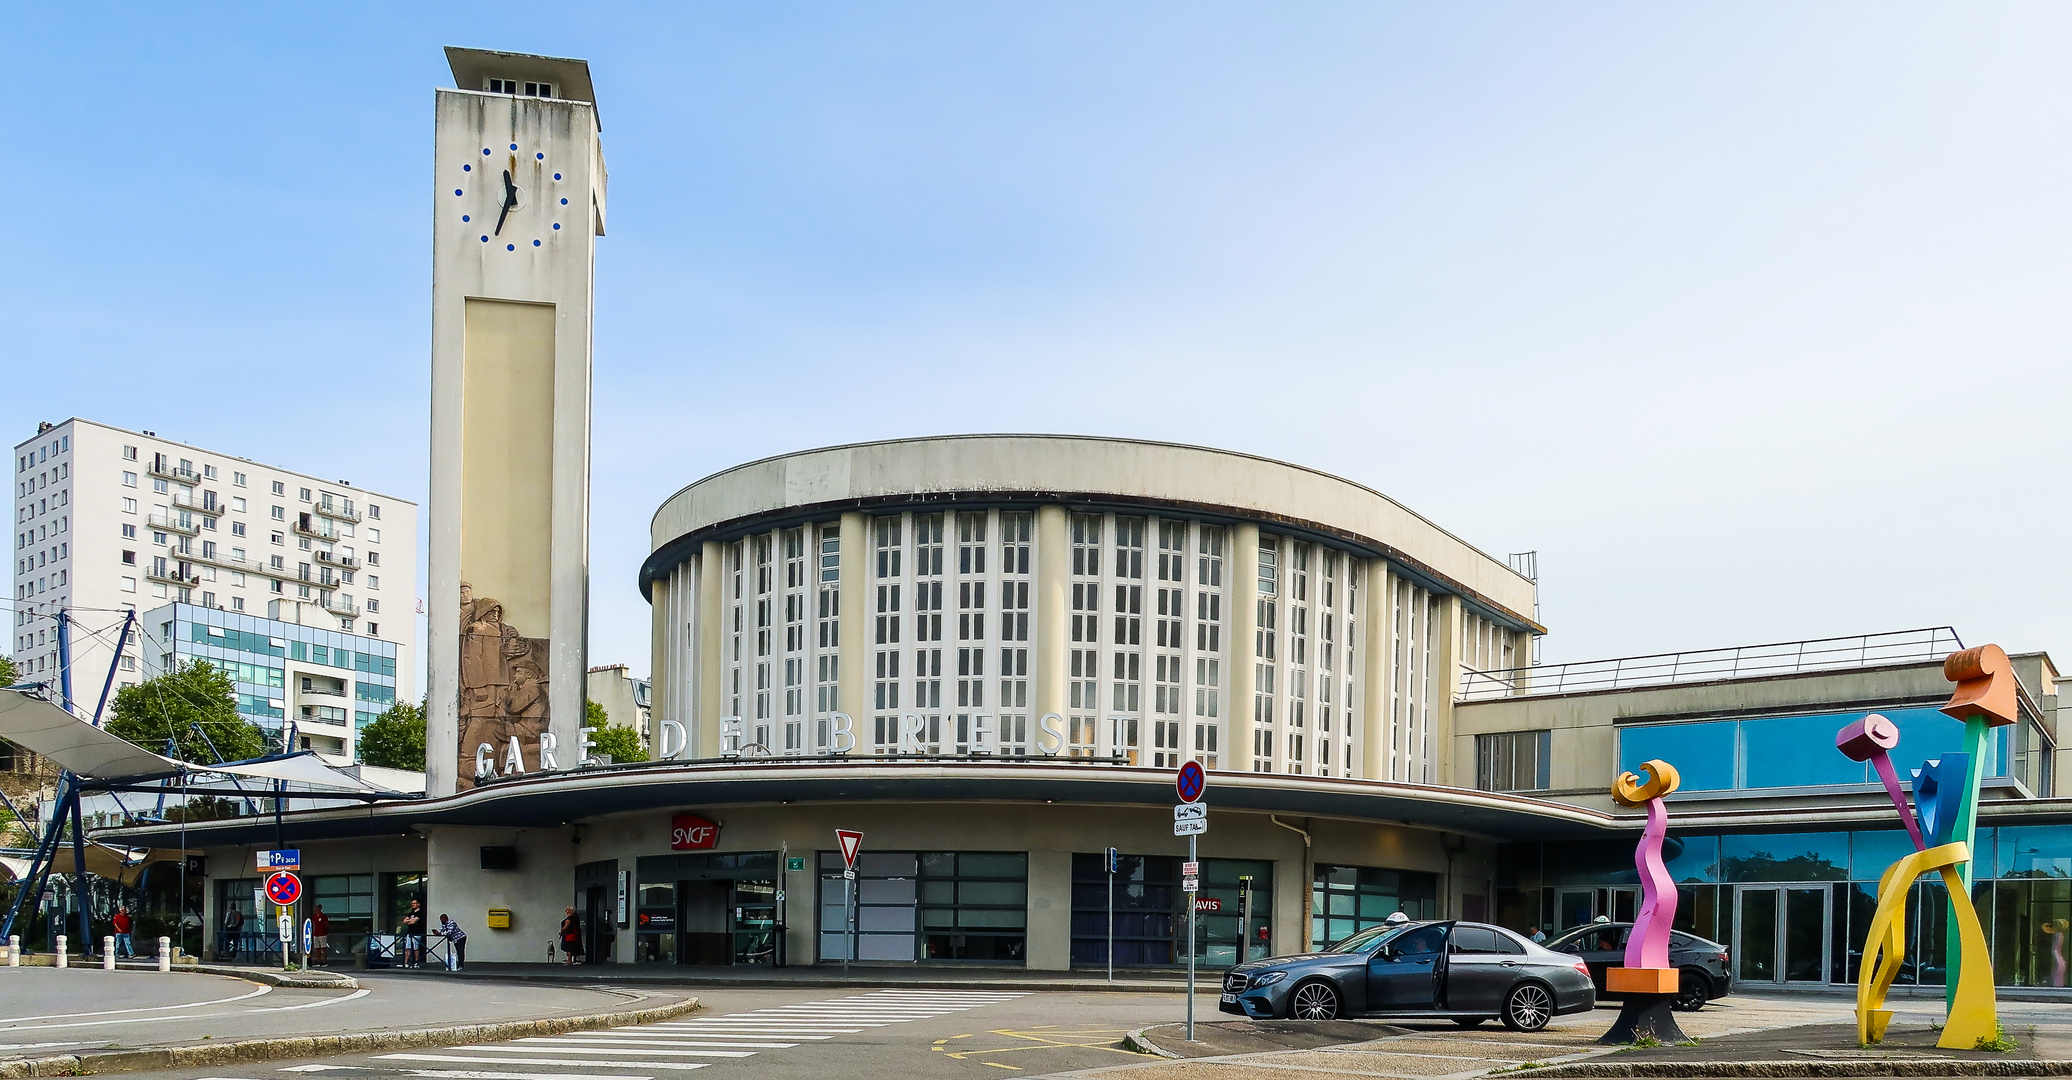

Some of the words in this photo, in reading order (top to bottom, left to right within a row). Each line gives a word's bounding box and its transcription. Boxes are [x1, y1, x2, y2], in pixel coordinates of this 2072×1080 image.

[475, 727, 597, 779] GARE
[660, 715, 741, 760] DE
[830, 711, 1132, 756] BREST
[672, 826, 713, 845] SNCF
[190, 860, 198, 871] P
[1195, 900, 1218, 910] AVIS
